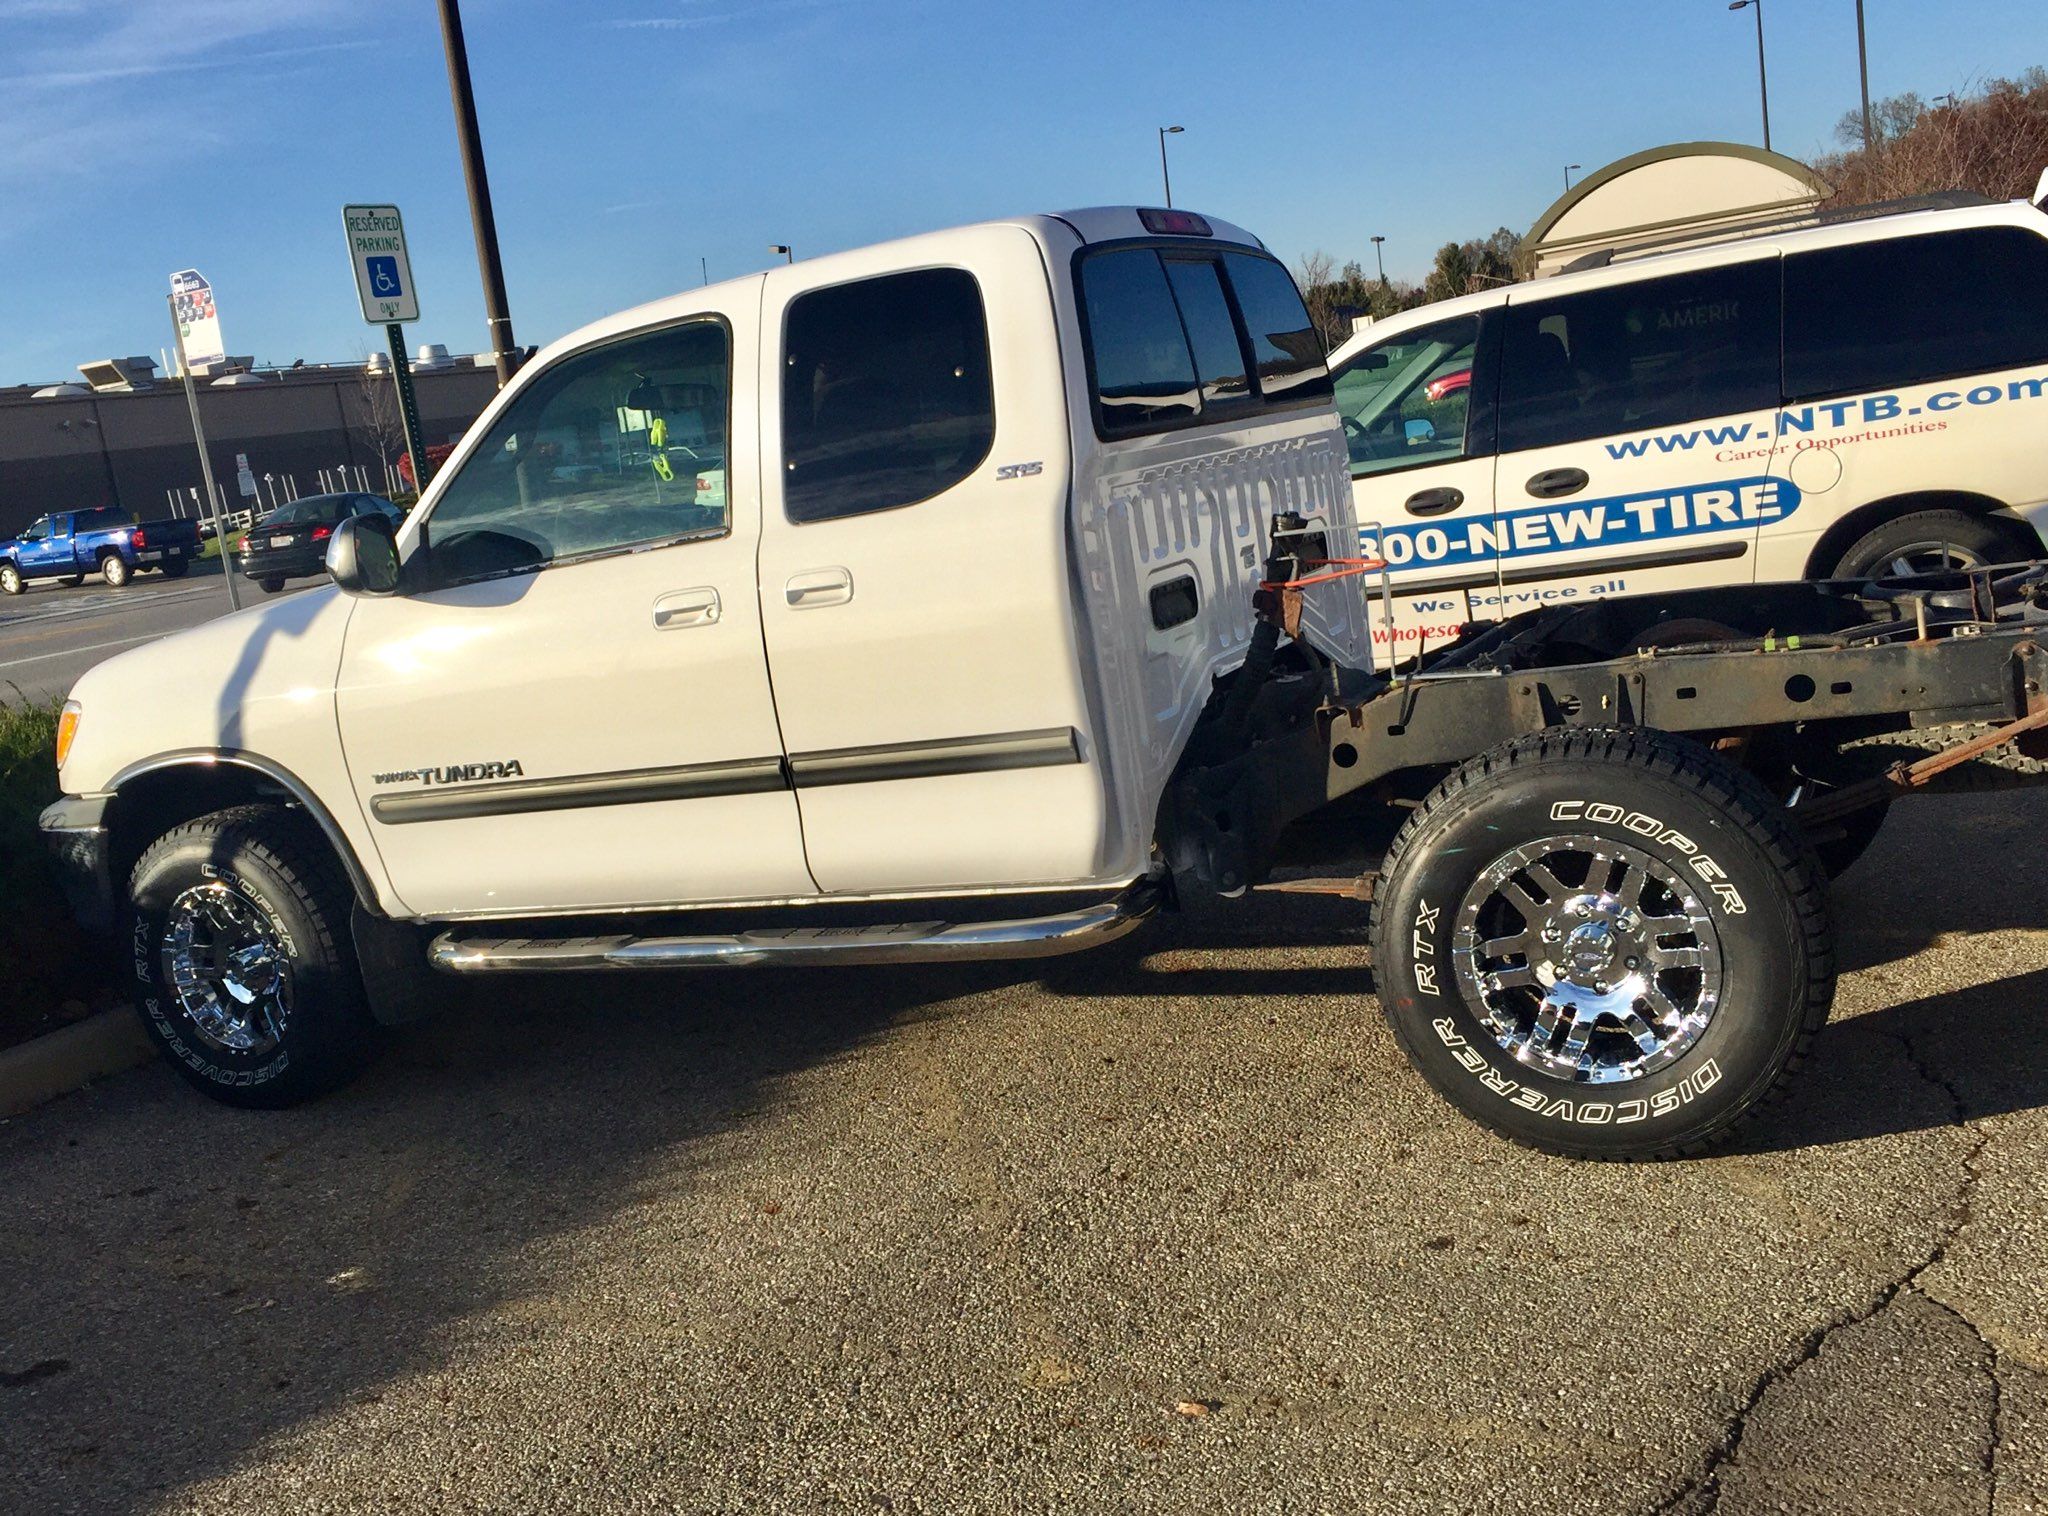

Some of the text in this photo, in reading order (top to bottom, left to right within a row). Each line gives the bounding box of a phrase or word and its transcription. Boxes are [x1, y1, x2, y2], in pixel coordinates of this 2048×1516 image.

[349, 216, 400, 232] RESERVED
[356, 237, 400, 252] PARKING
[380, 302, 400, 314] ONLY
[1604, 375, 2048, 460] www.NTB.com
[1715, 419, 1948, 463] Career Opportunities
[1412, 579, 1627, 614] We Service all
[1372, 622, 1468, 645] Wholesa
[418, 759, 524, 785] TUNDRA
[1550, 800, 1747, 915] COOPER
[201, 863, 298, 958] COOPER
[135, 915, 289, 1087] DISCOVERER RTX
[1413, 899, 1723, 1125] DISCOVERER RTX
